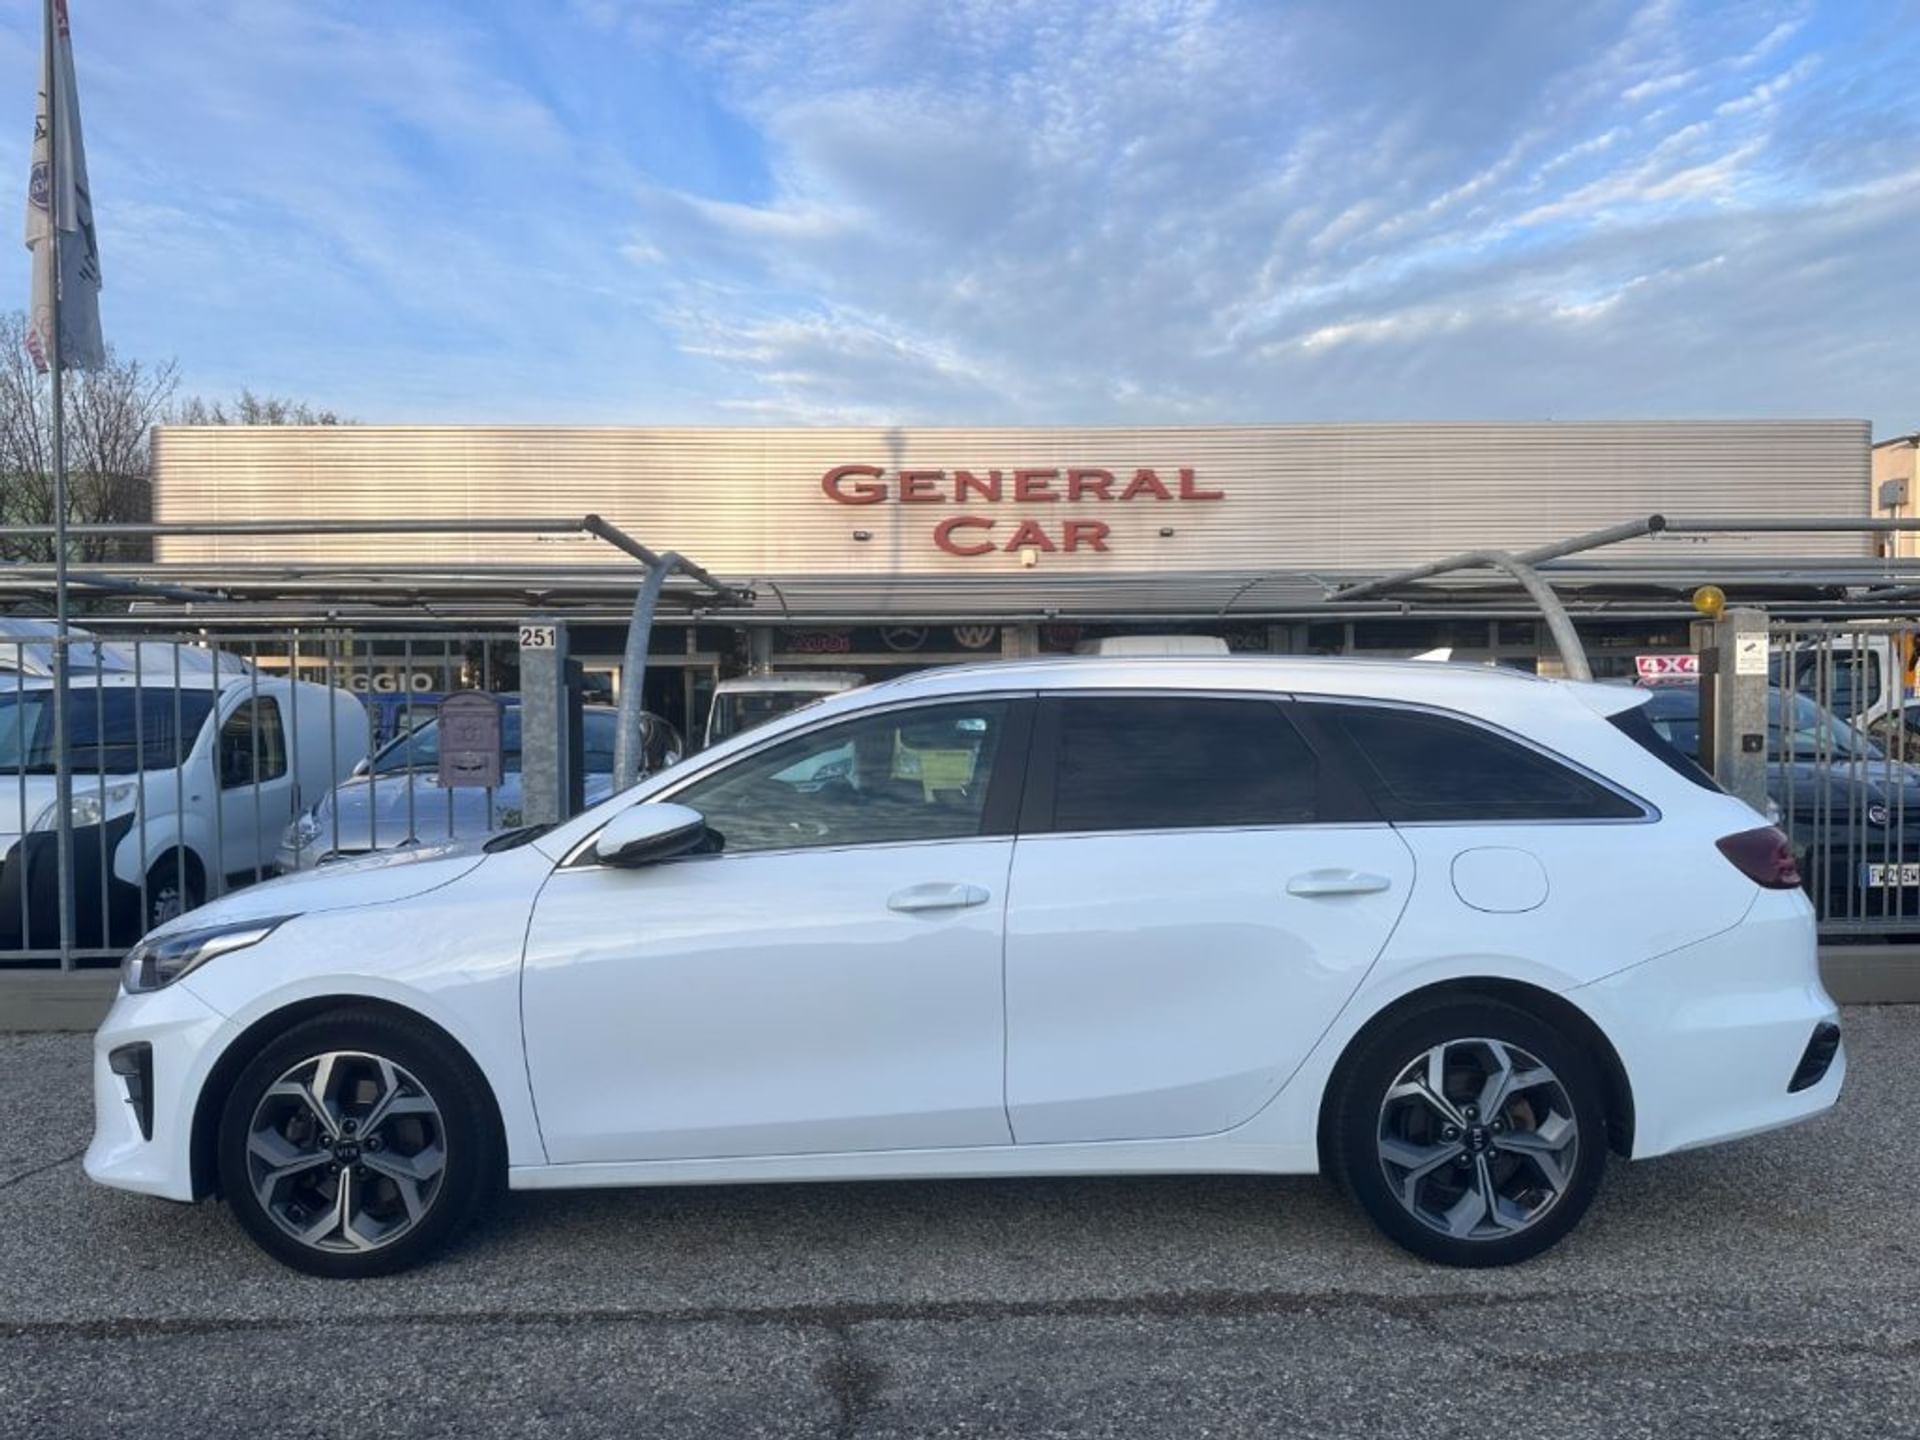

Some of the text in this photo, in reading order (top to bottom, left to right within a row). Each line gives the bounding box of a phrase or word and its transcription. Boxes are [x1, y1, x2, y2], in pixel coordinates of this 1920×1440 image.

[822, 465, 1225, 504] GENERAL
[934, 516, 1111, 556] CAR
[521, 629, 554, 646] 251
